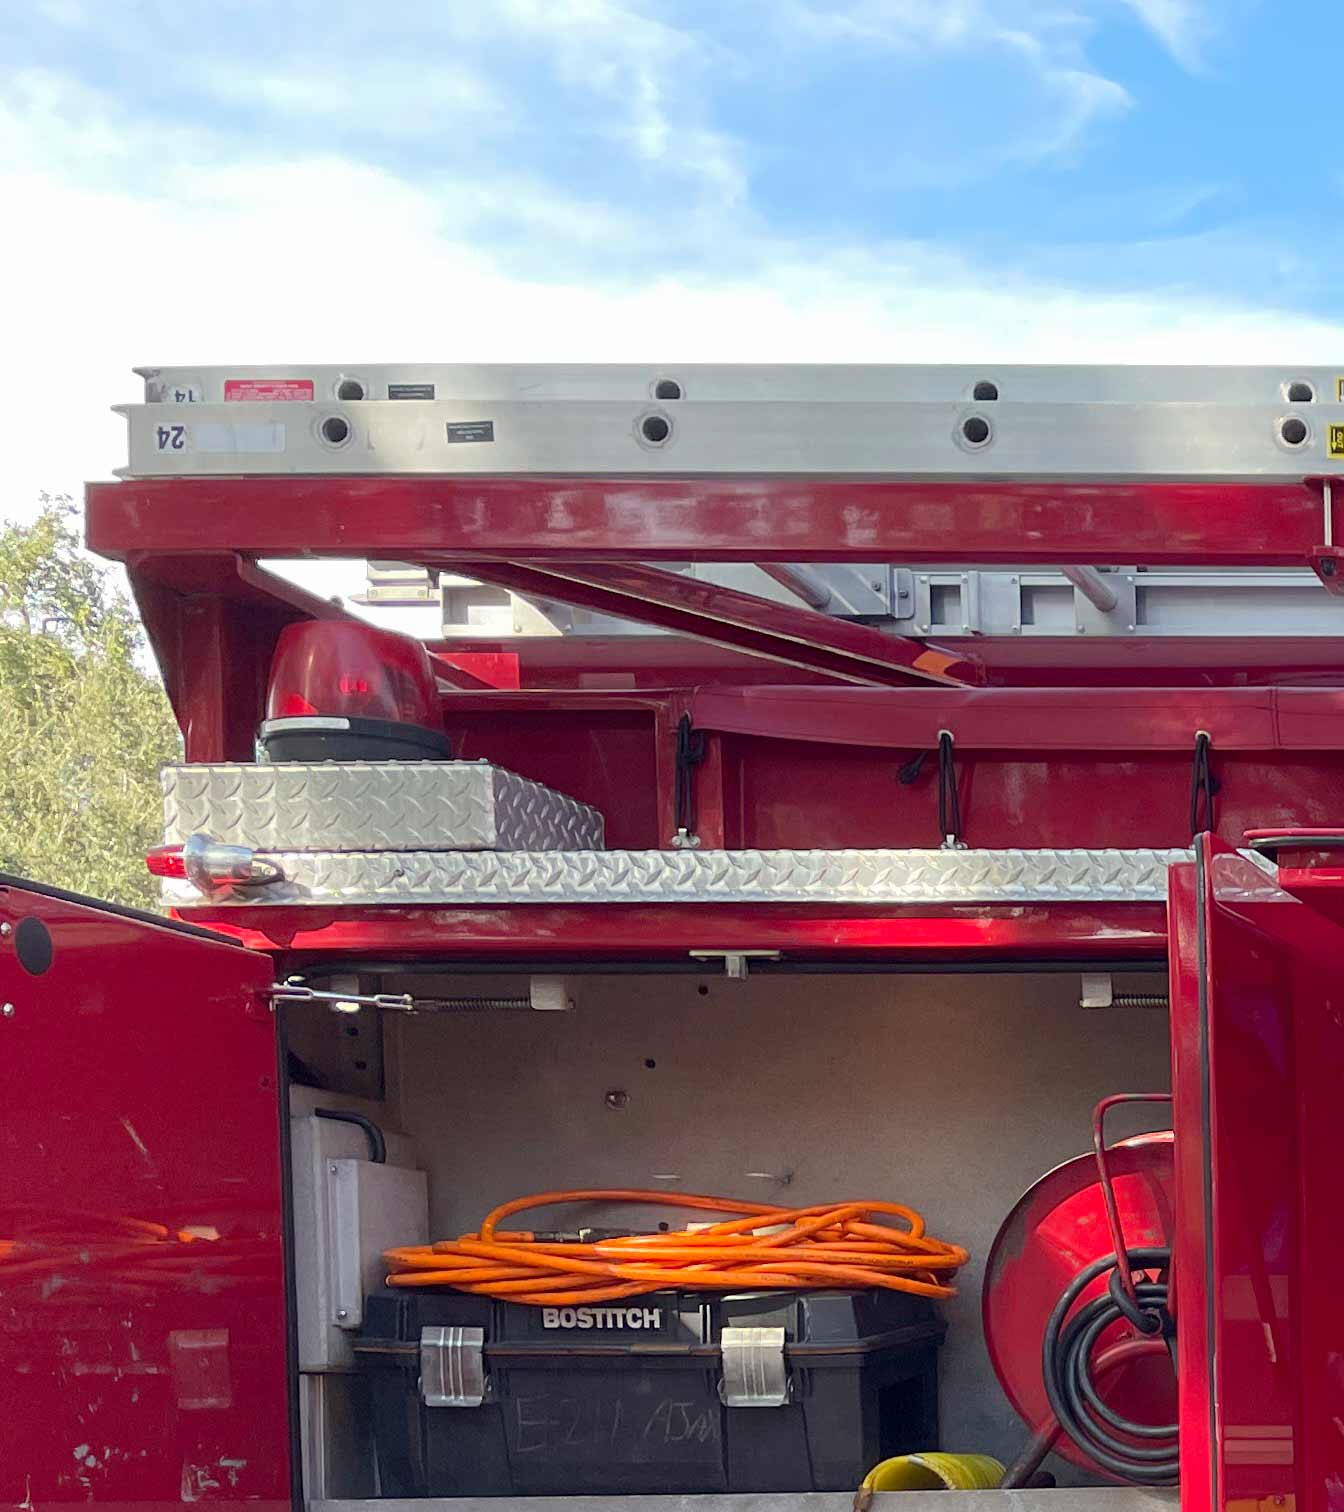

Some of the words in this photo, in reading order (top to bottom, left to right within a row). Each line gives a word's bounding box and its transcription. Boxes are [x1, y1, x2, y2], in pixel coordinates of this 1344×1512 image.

[175, 389, 196, 402] 14
[157, 426, 184, 449] 24
[543, 1308, 661, 1329] BOSTITCH
